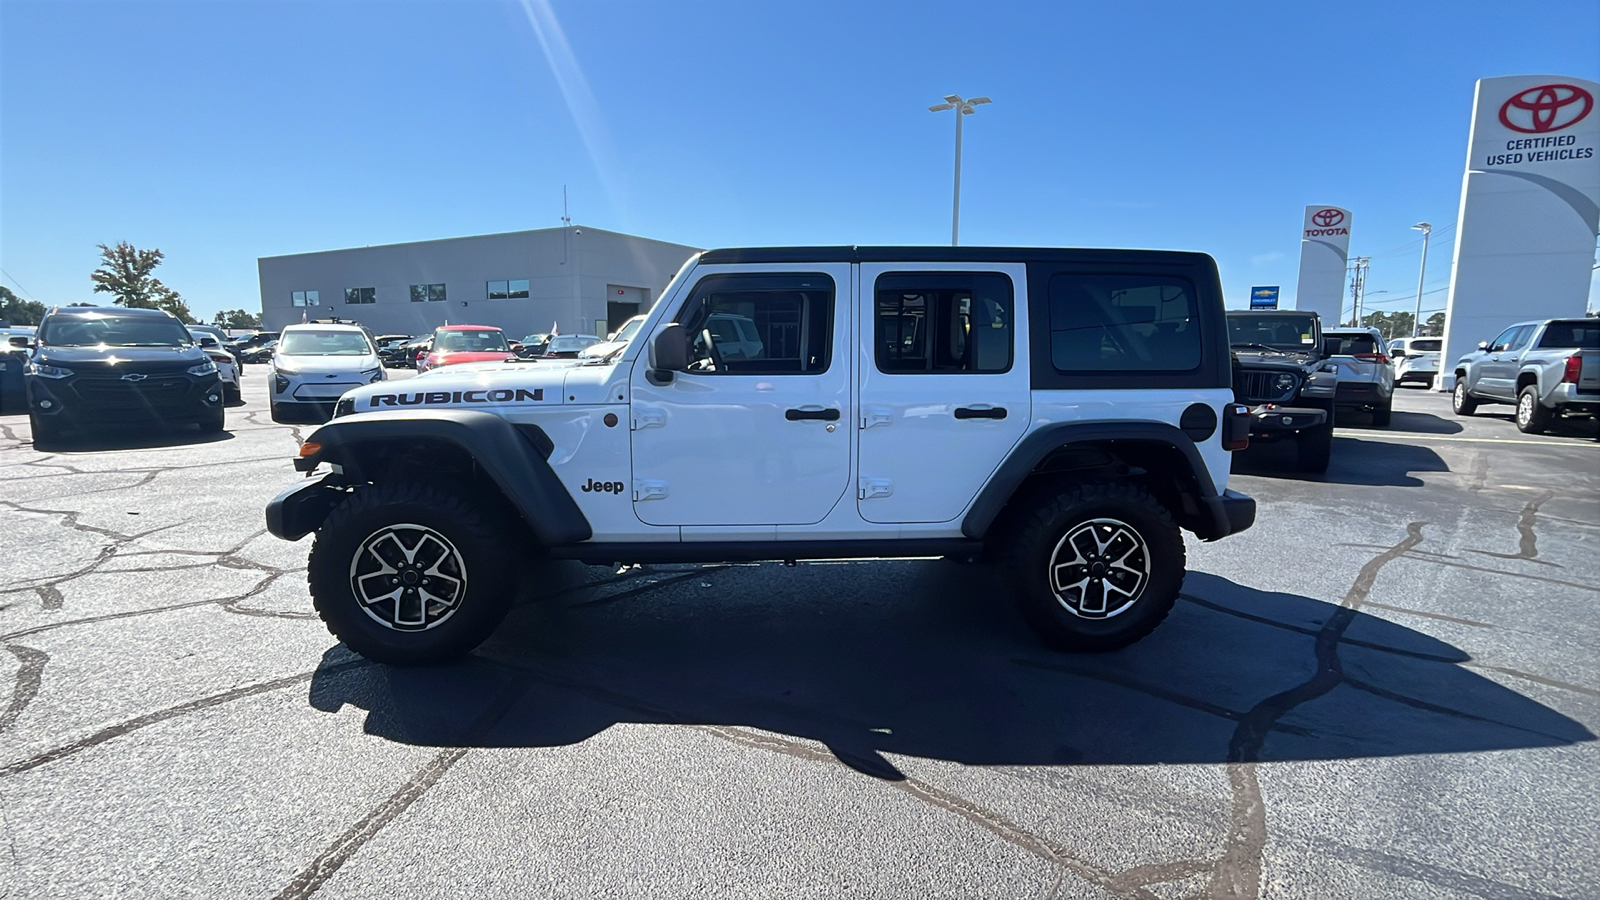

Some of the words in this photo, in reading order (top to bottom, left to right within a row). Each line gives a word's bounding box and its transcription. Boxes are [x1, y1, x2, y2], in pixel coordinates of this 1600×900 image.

[1506, 135, 1576, 151] CERTIFIED
[1486, 153, 1523, 166] USED
[1527, 147, 1593, 162] VEHICLES
[1305, 227, 1348, 237] TOYOTA
[370, 388, 544, 407] RUBICON
[581, 478, 624, 495] Jeep
